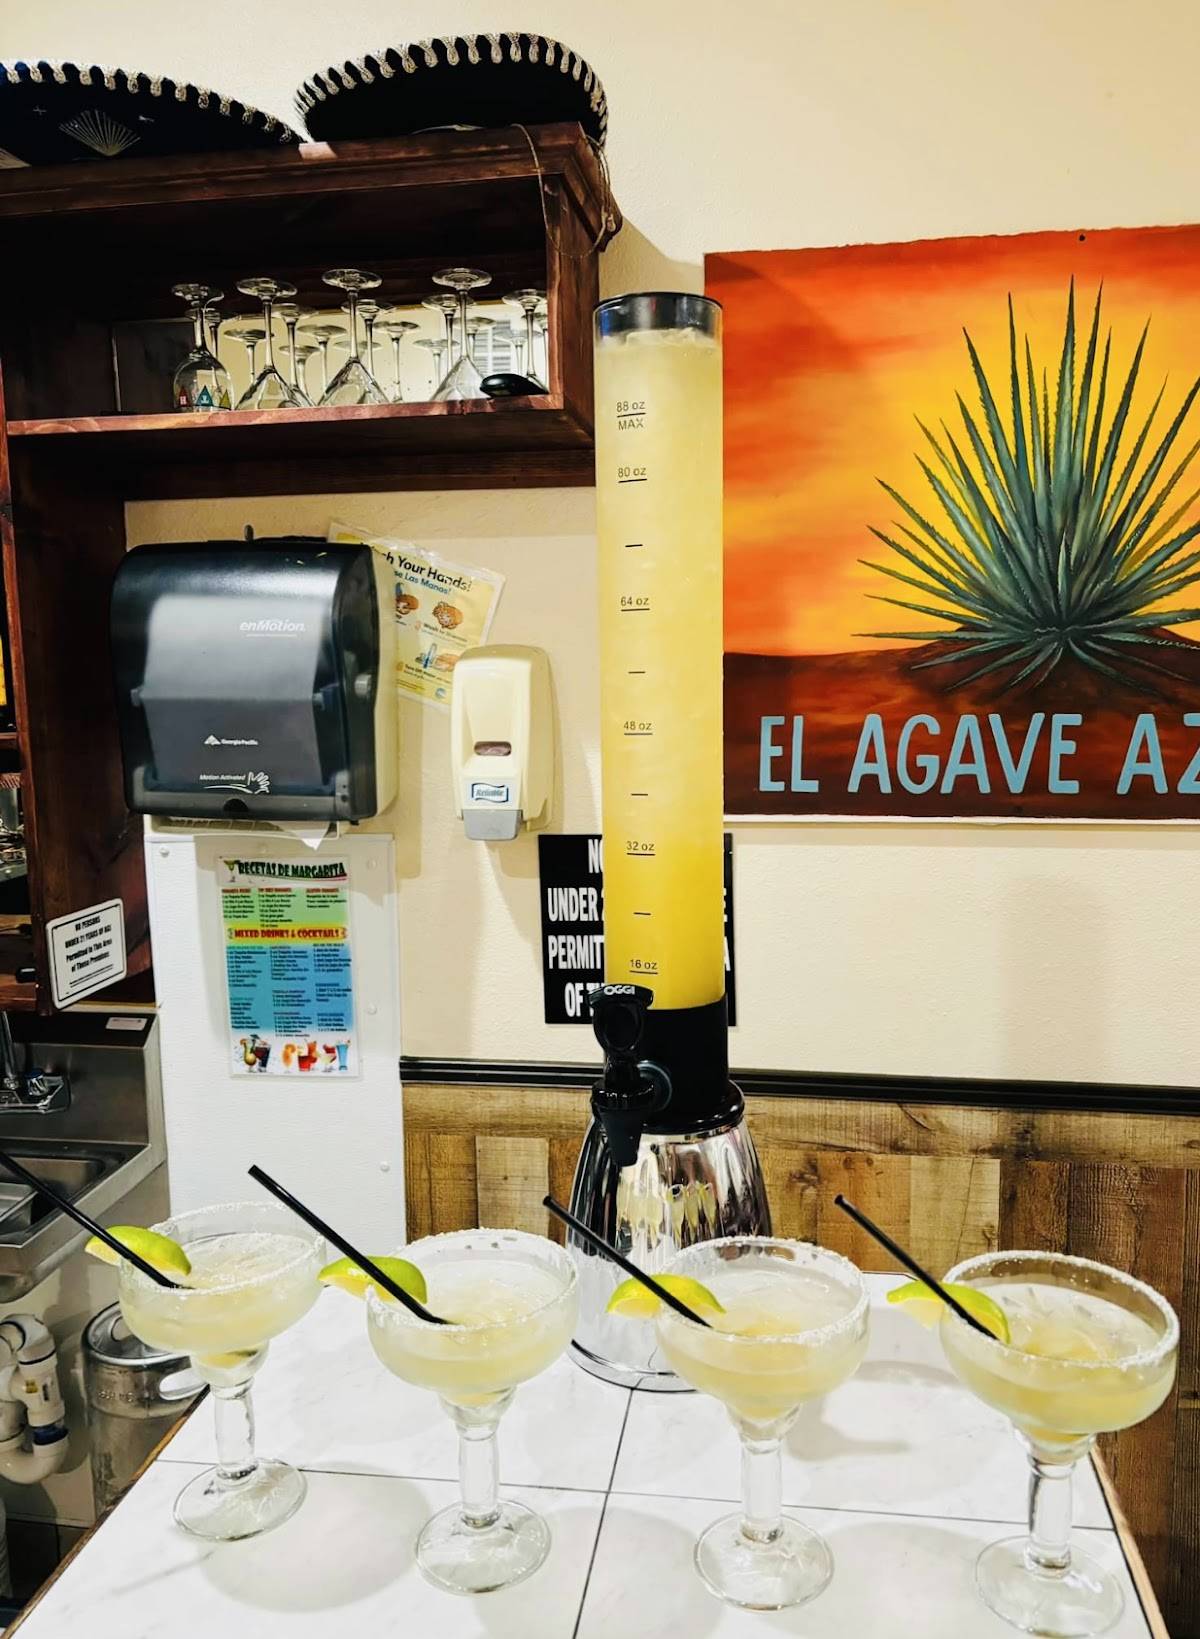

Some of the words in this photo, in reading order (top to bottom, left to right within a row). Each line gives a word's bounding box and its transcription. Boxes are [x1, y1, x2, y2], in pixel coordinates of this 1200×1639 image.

[616, 401, 629, 412] 88
[632, 401, 645, 410] oz
[618, 418, 644, 431] MAX
[617, 466, 630, 478] 80
[633, 467, 646, 476] oz
[397, 555, 426, 575] Your
[405, 572, 419, 584] Las
[620, 596, 632, 606] 64
[636, 597, 649, 606] oz
[240, 619, 304, 632] enMotion
[623, 721, 636, 731] 48
[638, 722, 652, 731] oz
[760, 715, 819, 793] EL
[848, 712, 1082, 795] AGAVE
[626, 840, 638, 851] 32
[641, 842, 655, 851] oz
[588, 838, 605, 873] N
[238, 861, 277, 876] RECETAS
[279, 863, 289, 877] DE
[291, 862, 346, 878] MARGARITA
[547, 887, 599, 922] UNDER
[234, 929, 259, 938] MIXED
[261, 929, 289, 938] DRINKS
[297, 929, 340, 938] COCKTAILS
[629, 959, 641, 969] 16
[644, 961, 658, 970] oz
[604, 984, 635, 996] OGGI
[564, 982, 584, 1017] OF
